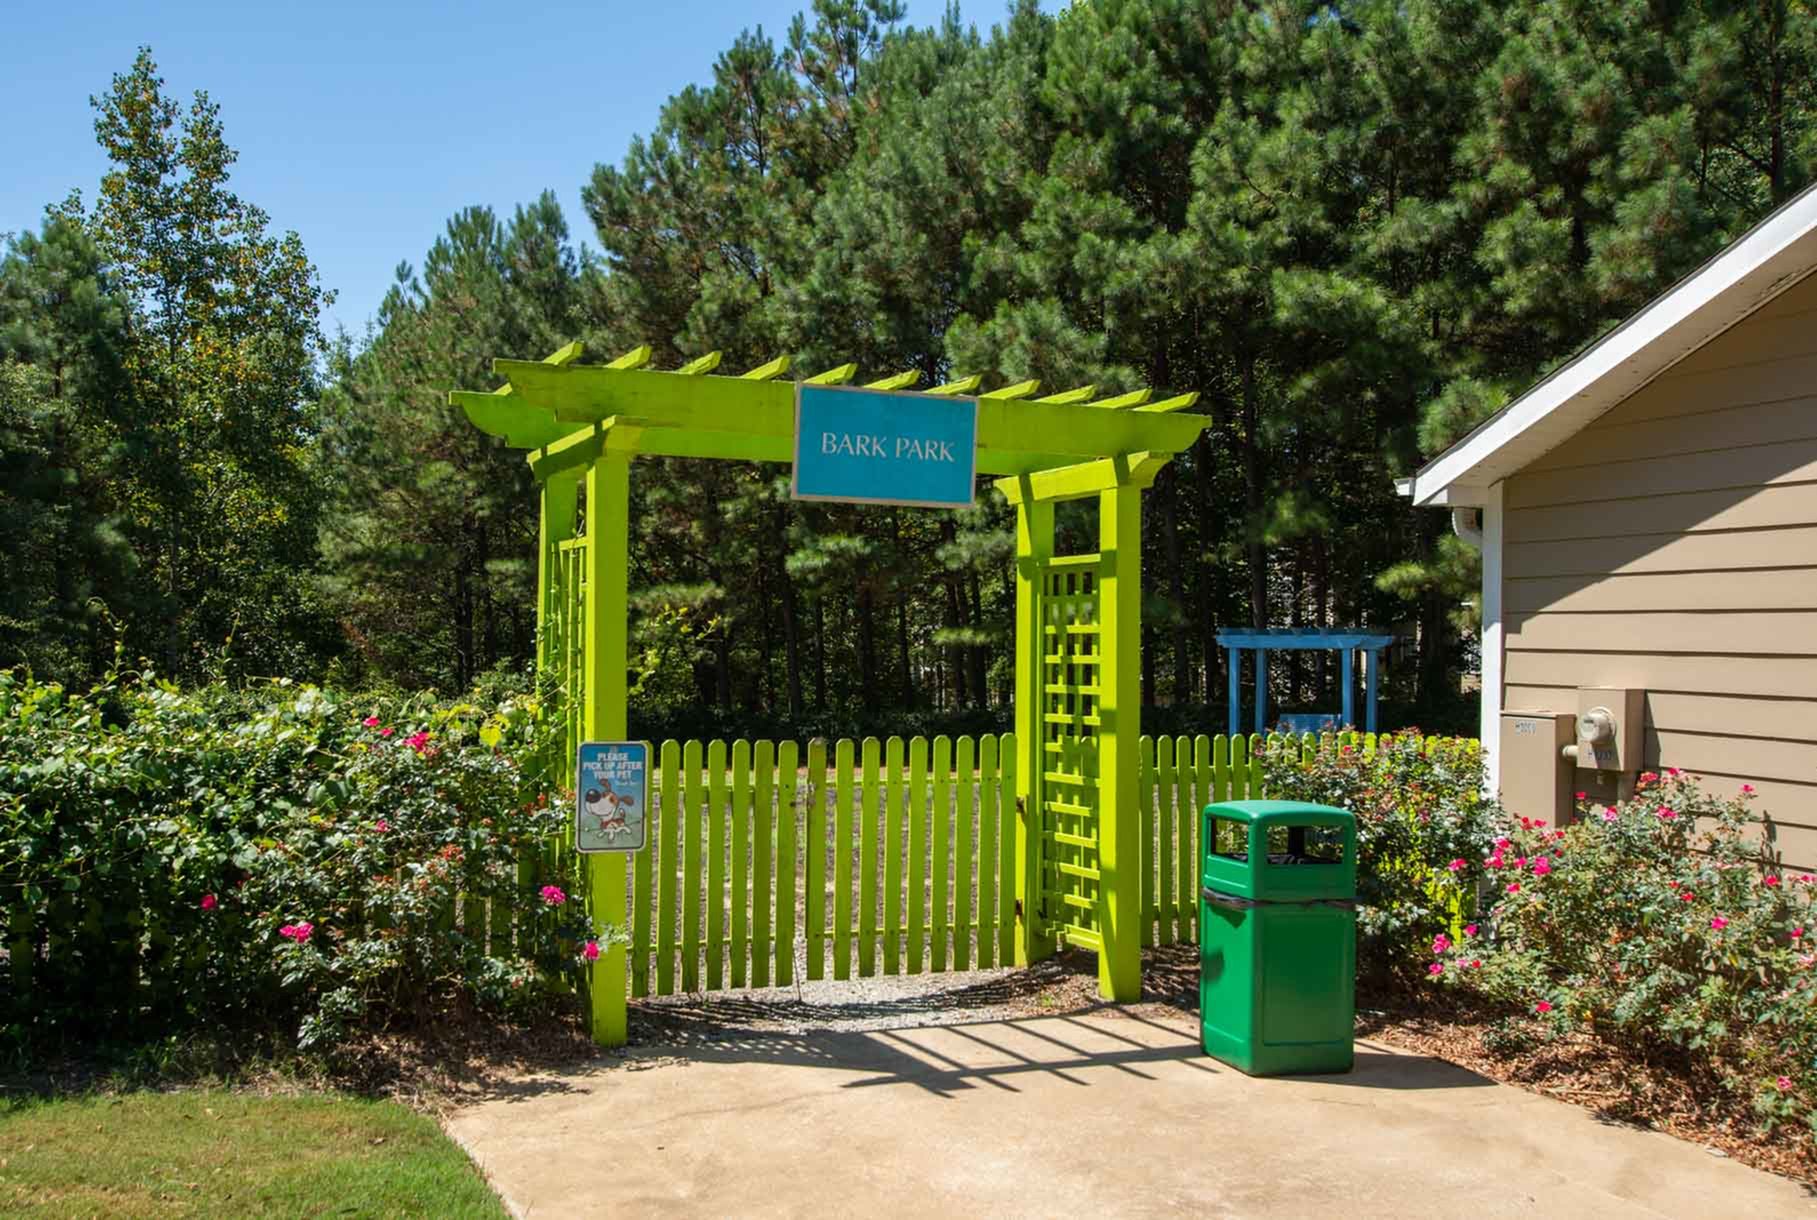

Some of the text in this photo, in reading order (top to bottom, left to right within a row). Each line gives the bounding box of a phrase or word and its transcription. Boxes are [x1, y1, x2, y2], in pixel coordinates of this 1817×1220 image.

[821, 432, 956, 463] BARK PARK
[597, 752, 629, 761] PLEASE
[582, 761, 642, 771] PICK UP AFTER
[593, 770, 632, 780] YOUR PET
